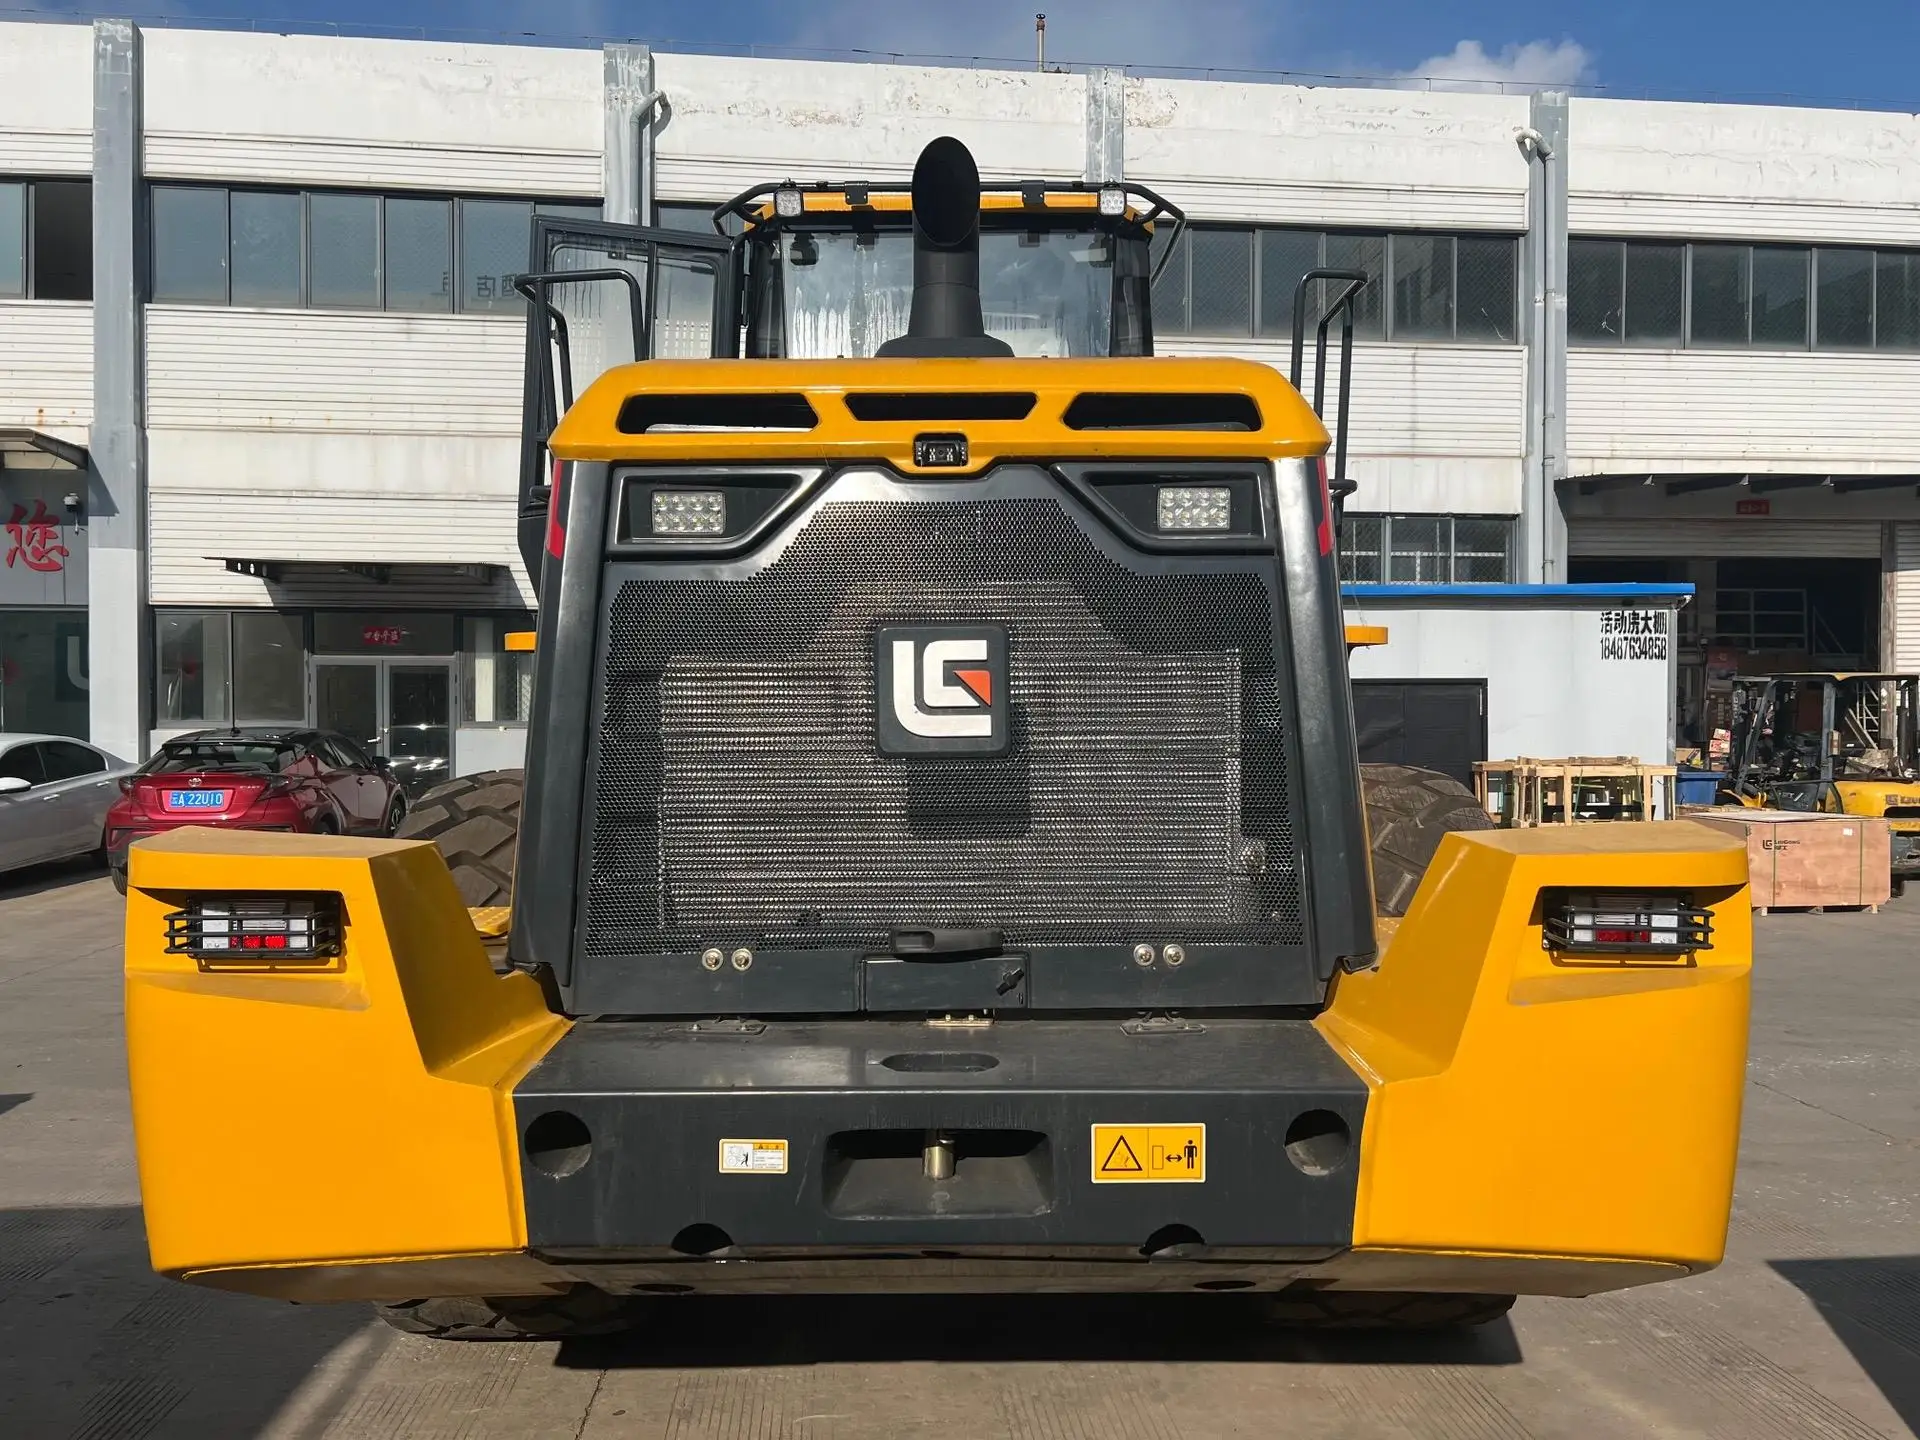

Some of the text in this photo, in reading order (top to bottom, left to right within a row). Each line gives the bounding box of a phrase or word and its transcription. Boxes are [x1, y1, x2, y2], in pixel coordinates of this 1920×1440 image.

[5, 499, 70, 572] 您
[1600, 636, 1667, 660] 18487634858
[893, 640, 992, 737] LG
